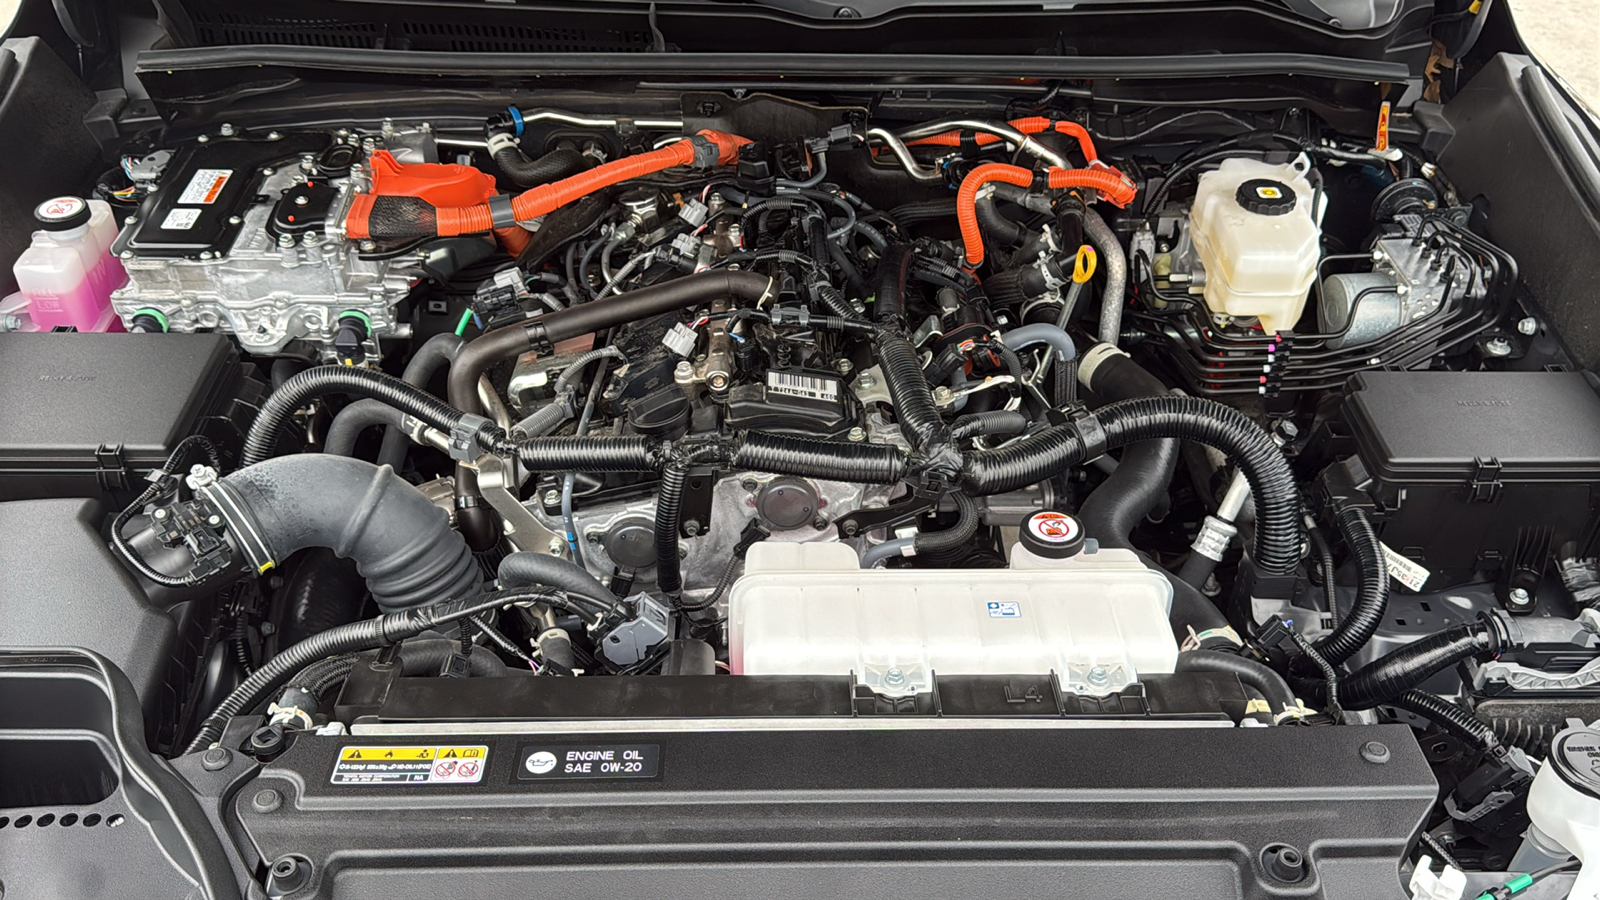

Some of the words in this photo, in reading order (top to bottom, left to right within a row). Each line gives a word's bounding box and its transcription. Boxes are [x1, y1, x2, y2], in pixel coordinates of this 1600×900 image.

[37, 301, 60, 309] LOW
[1004, 685, 1043, 702] L4
[566, 751, 615, 761] ENGINE
[623, 750, 644, 760] OIL
[564, 763, 592, 773] SAE
[600, 762, 642, 772] 0W-20
